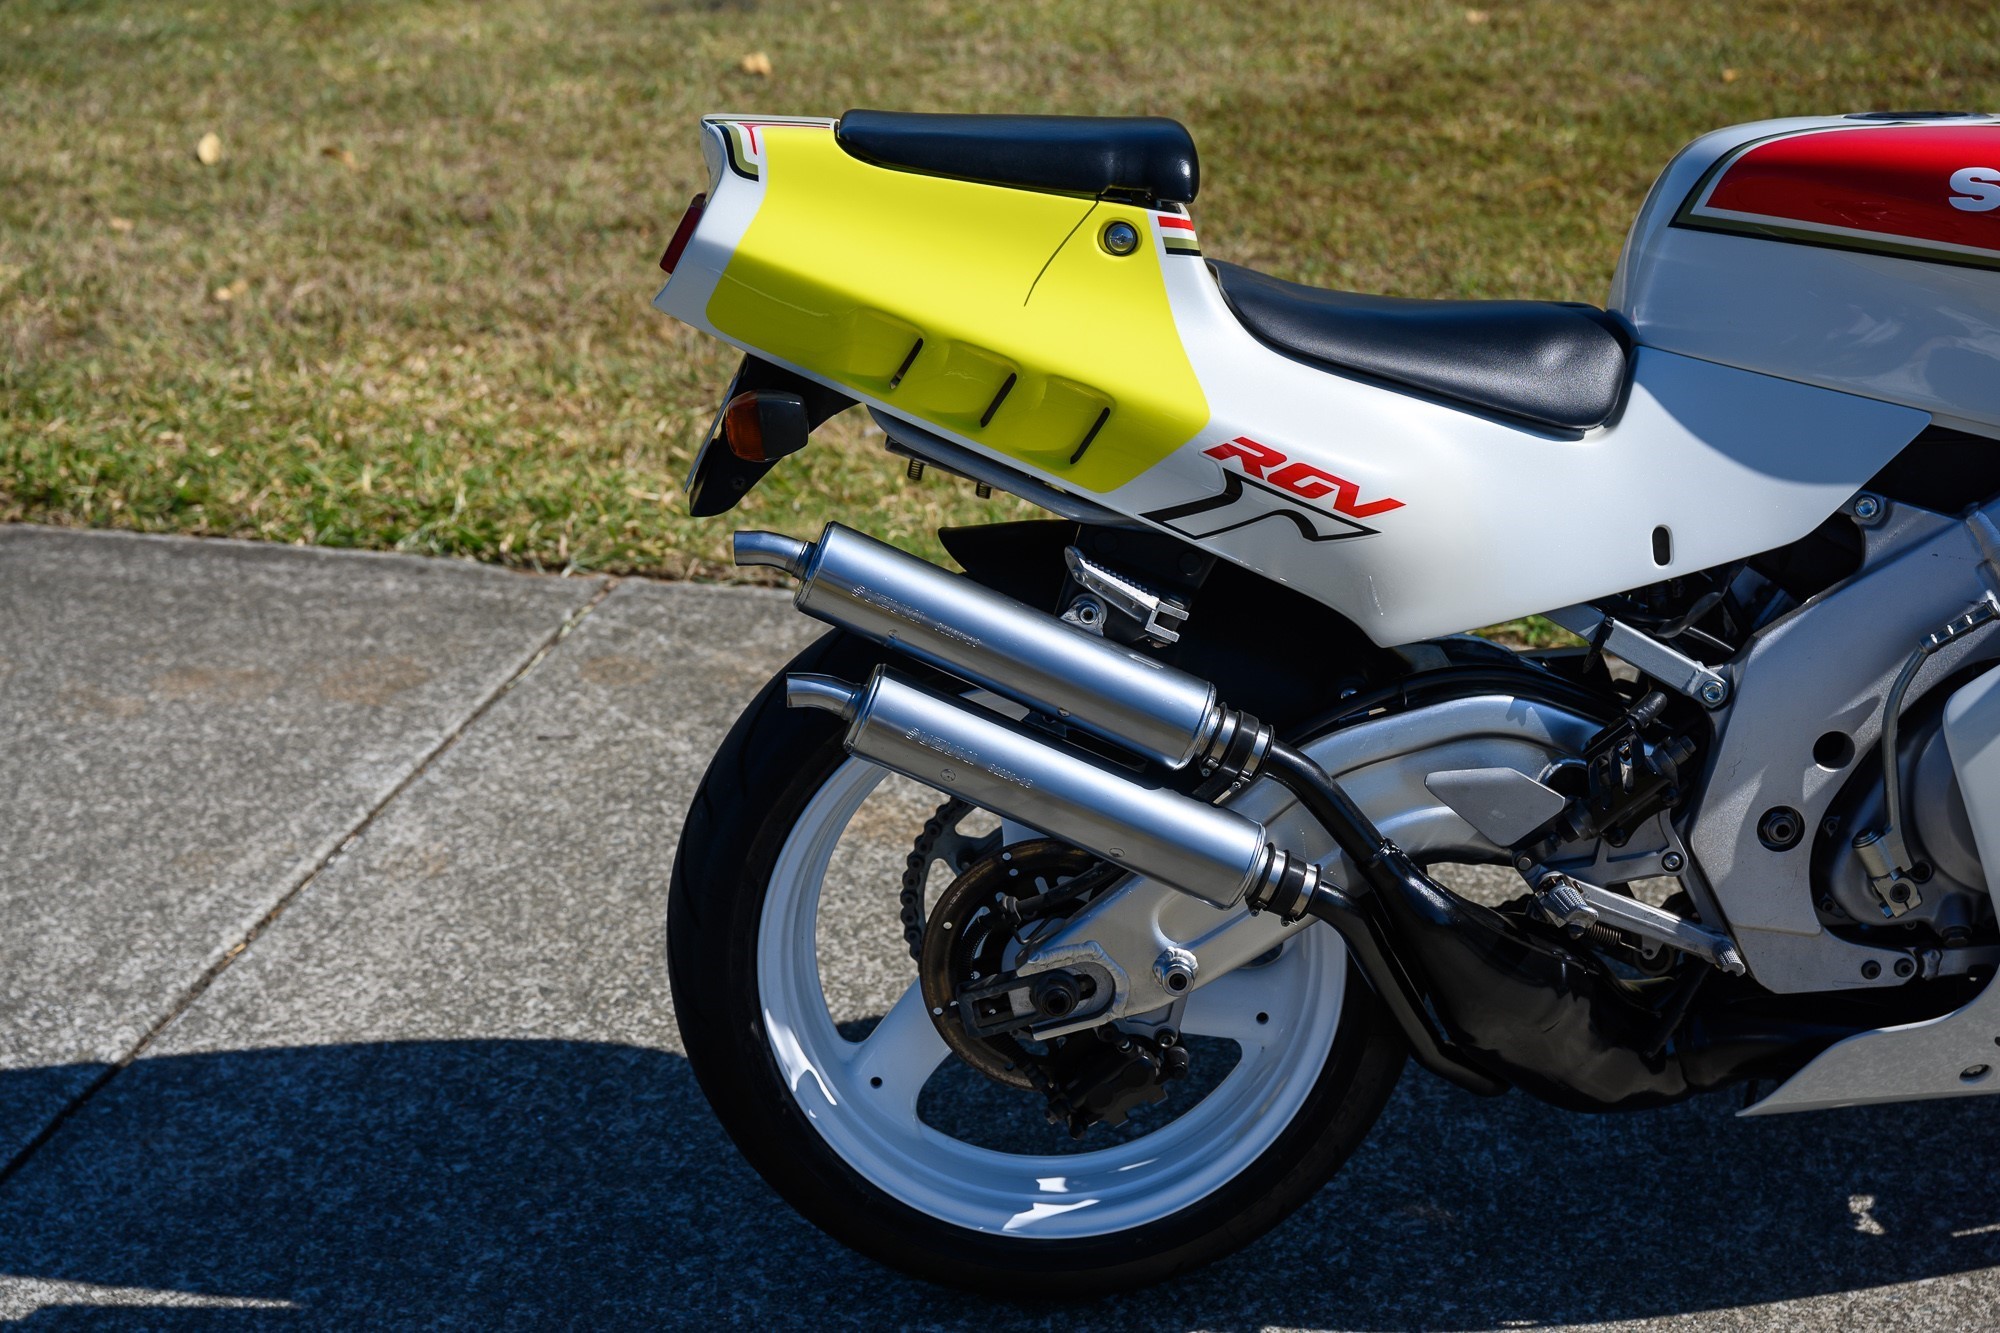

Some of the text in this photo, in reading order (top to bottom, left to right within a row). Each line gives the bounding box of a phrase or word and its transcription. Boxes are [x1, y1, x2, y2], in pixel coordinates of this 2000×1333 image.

[1948, 166, 2000, 212] S
[1202, 436, 1407, 519] RGV
[851, 585, 925, 624] SUZUKI
[905, 727, 978, 766] SUZUKI
